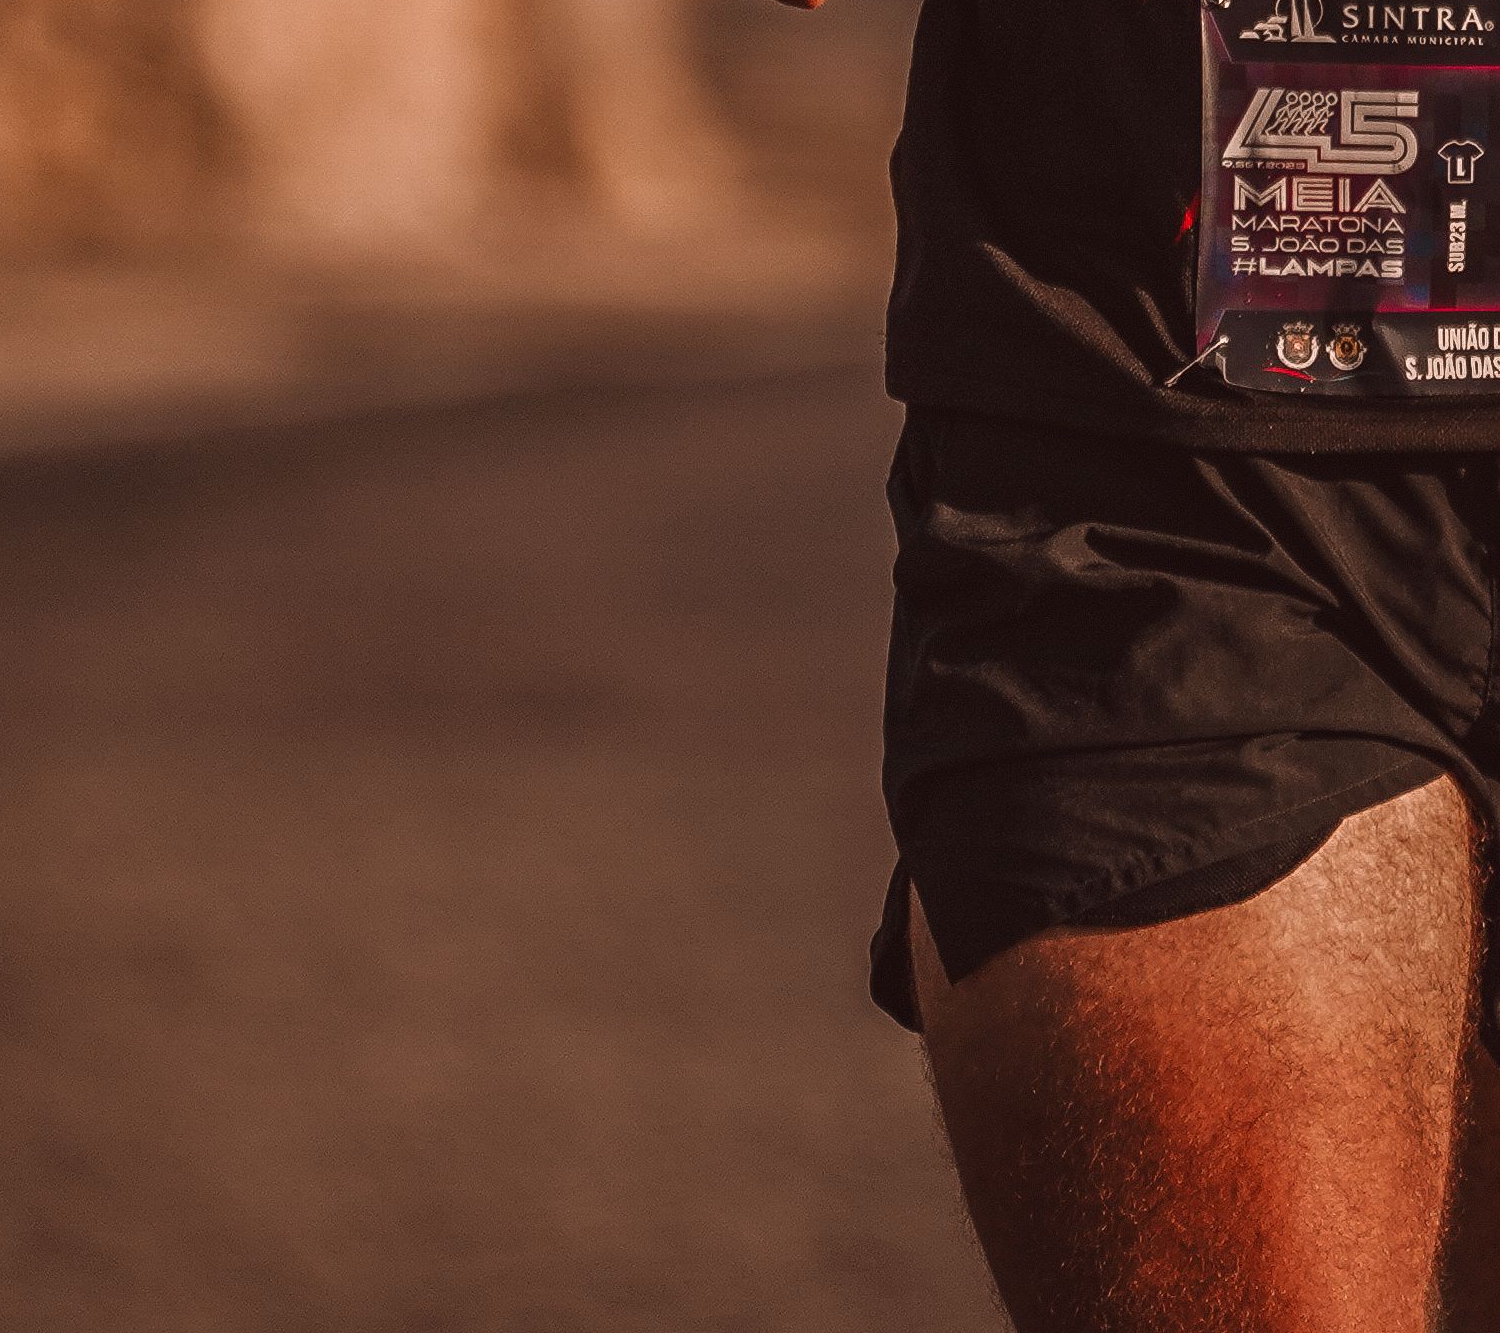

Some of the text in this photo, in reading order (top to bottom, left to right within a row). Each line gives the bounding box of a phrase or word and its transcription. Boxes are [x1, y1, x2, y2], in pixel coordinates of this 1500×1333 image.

[1407, 36, 1484, 47] MUNICIPAL
[1233, 175, 1407, 213] MEIA
[1231, 215, 1405, 234] MARATONA
[1231, 234, 1405, 254] S. JOÃO DAS
[1447, 222, 1467, 273] SUB23
[1231, 256, 1404, 278] #LAMPAS
[1437, 322, 1490, 351] UNIÃO
[1405, 356, 1423, 381] S.
[1425, 353, 1468, 380] JOÃO
